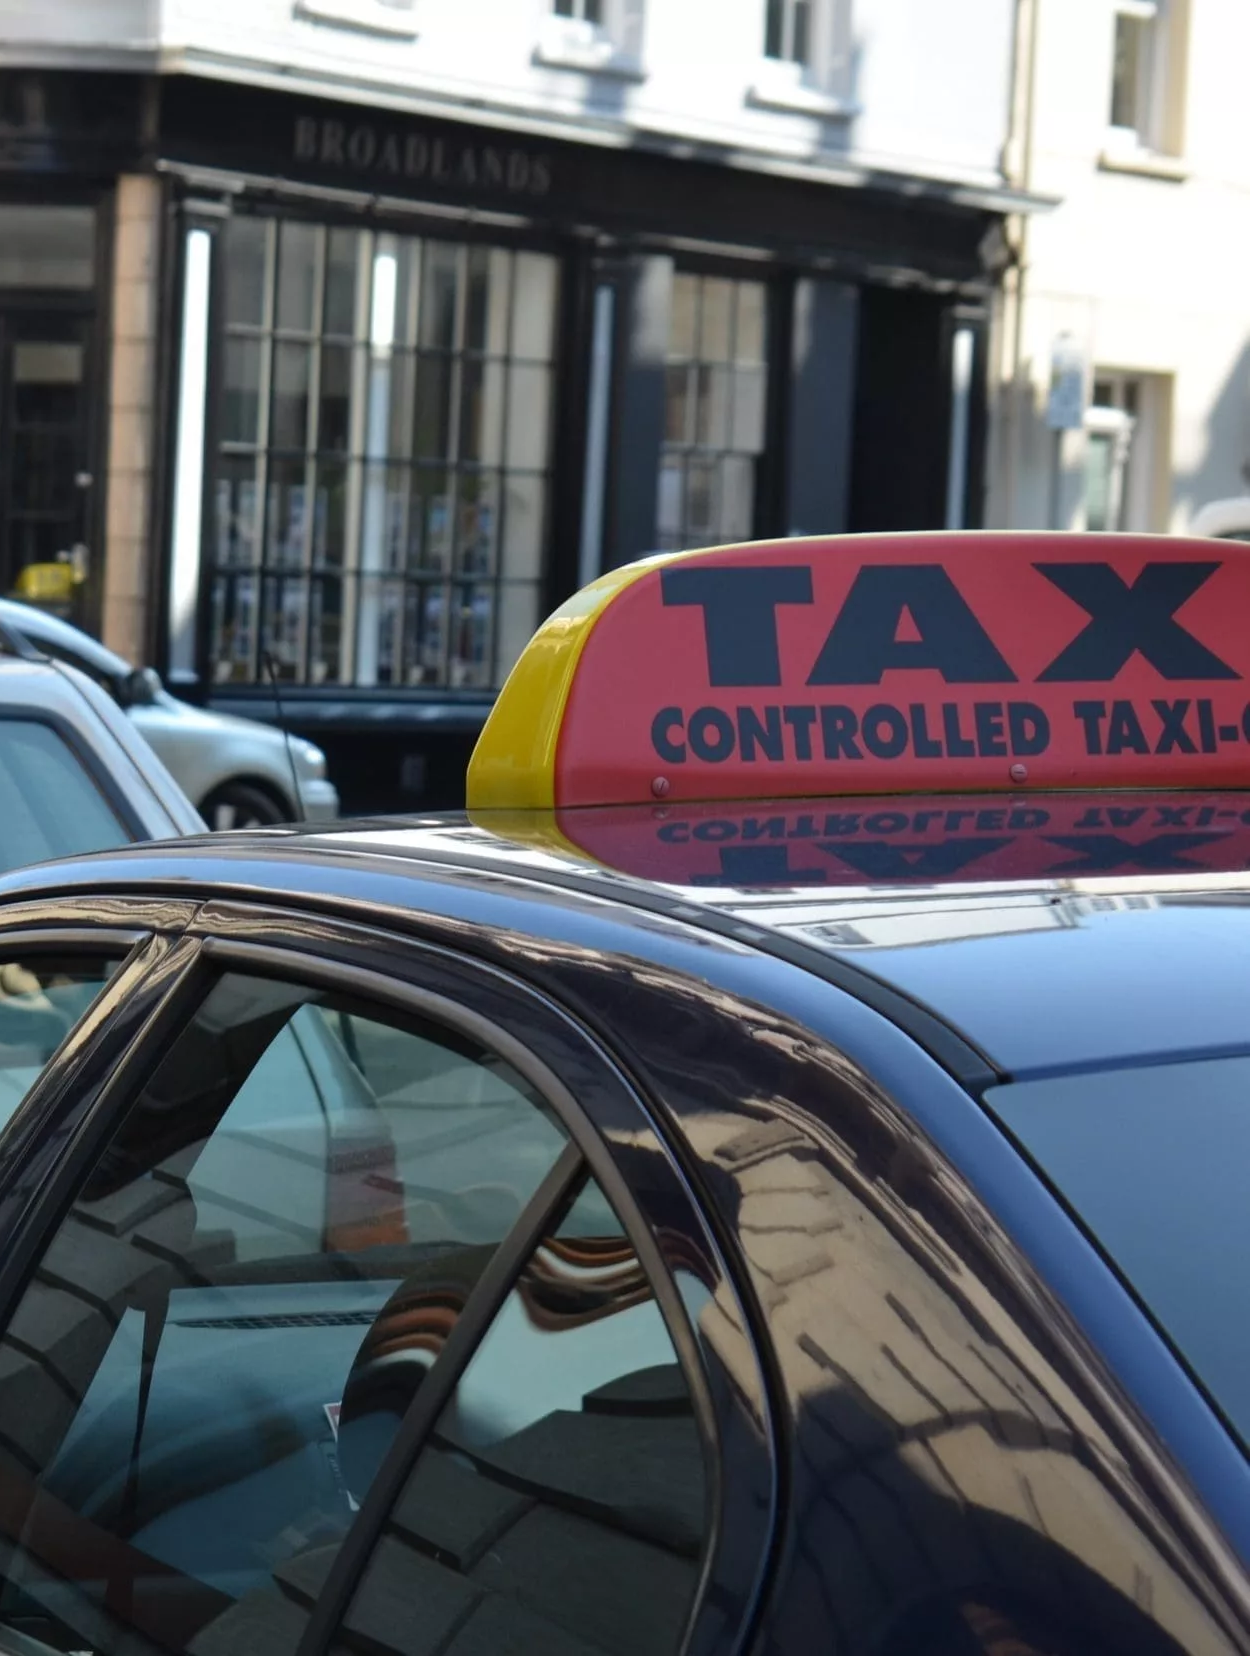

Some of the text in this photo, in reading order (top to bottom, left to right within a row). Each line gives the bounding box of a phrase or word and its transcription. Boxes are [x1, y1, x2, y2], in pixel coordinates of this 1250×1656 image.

[293, 115, 551, 195] BROADLANDS
[650, 697, 1250, 764] CONTROLLED TAXI-
